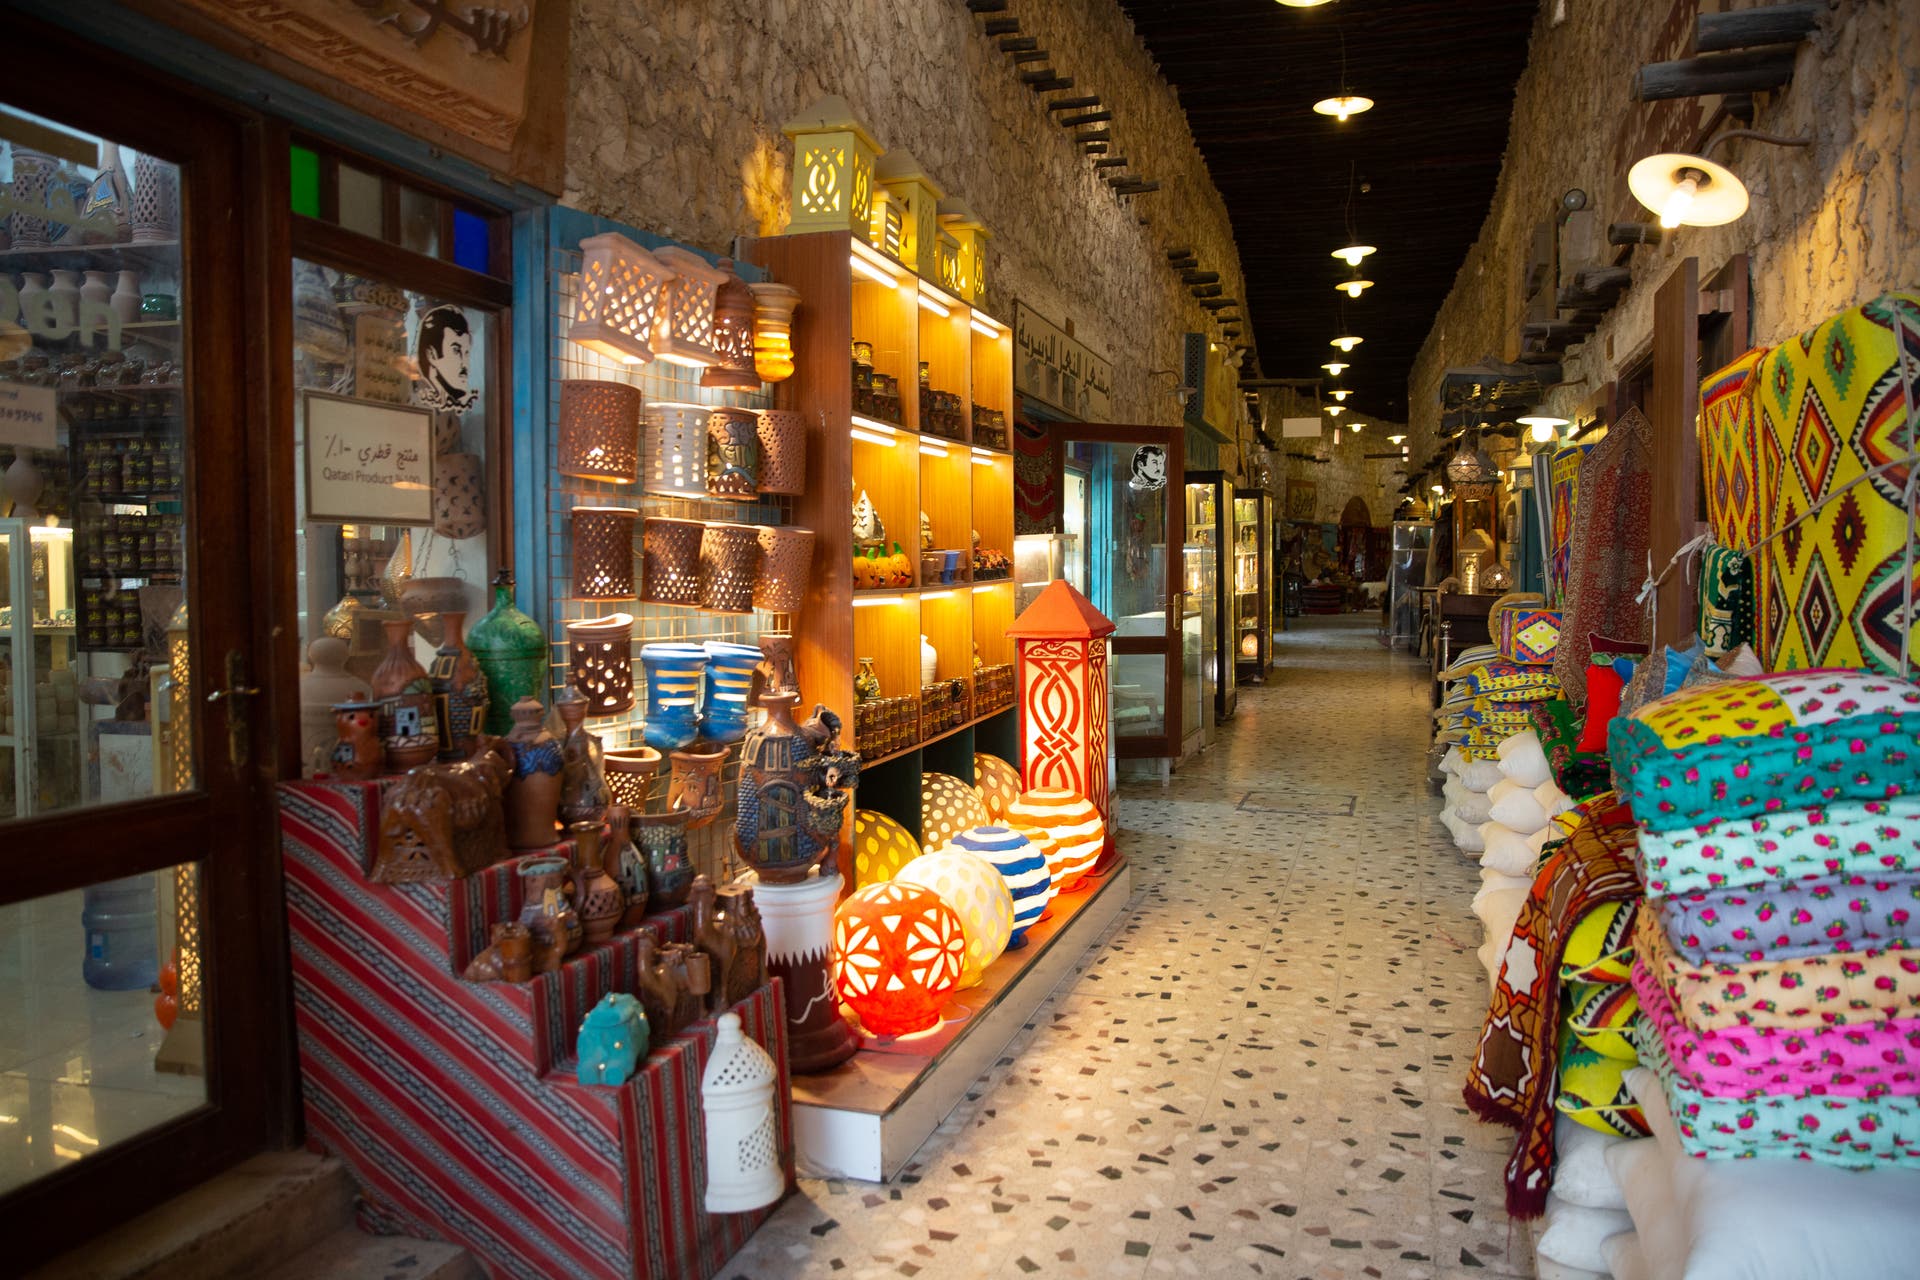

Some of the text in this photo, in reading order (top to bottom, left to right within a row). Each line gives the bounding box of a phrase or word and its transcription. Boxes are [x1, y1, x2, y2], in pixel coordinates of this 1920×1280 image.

[357, 443, 392, 467] قطري
[396, 447, 419, 471] منتج
[322, 465, 354, 483] Qatari
[355, 468, 393, 485] Product
